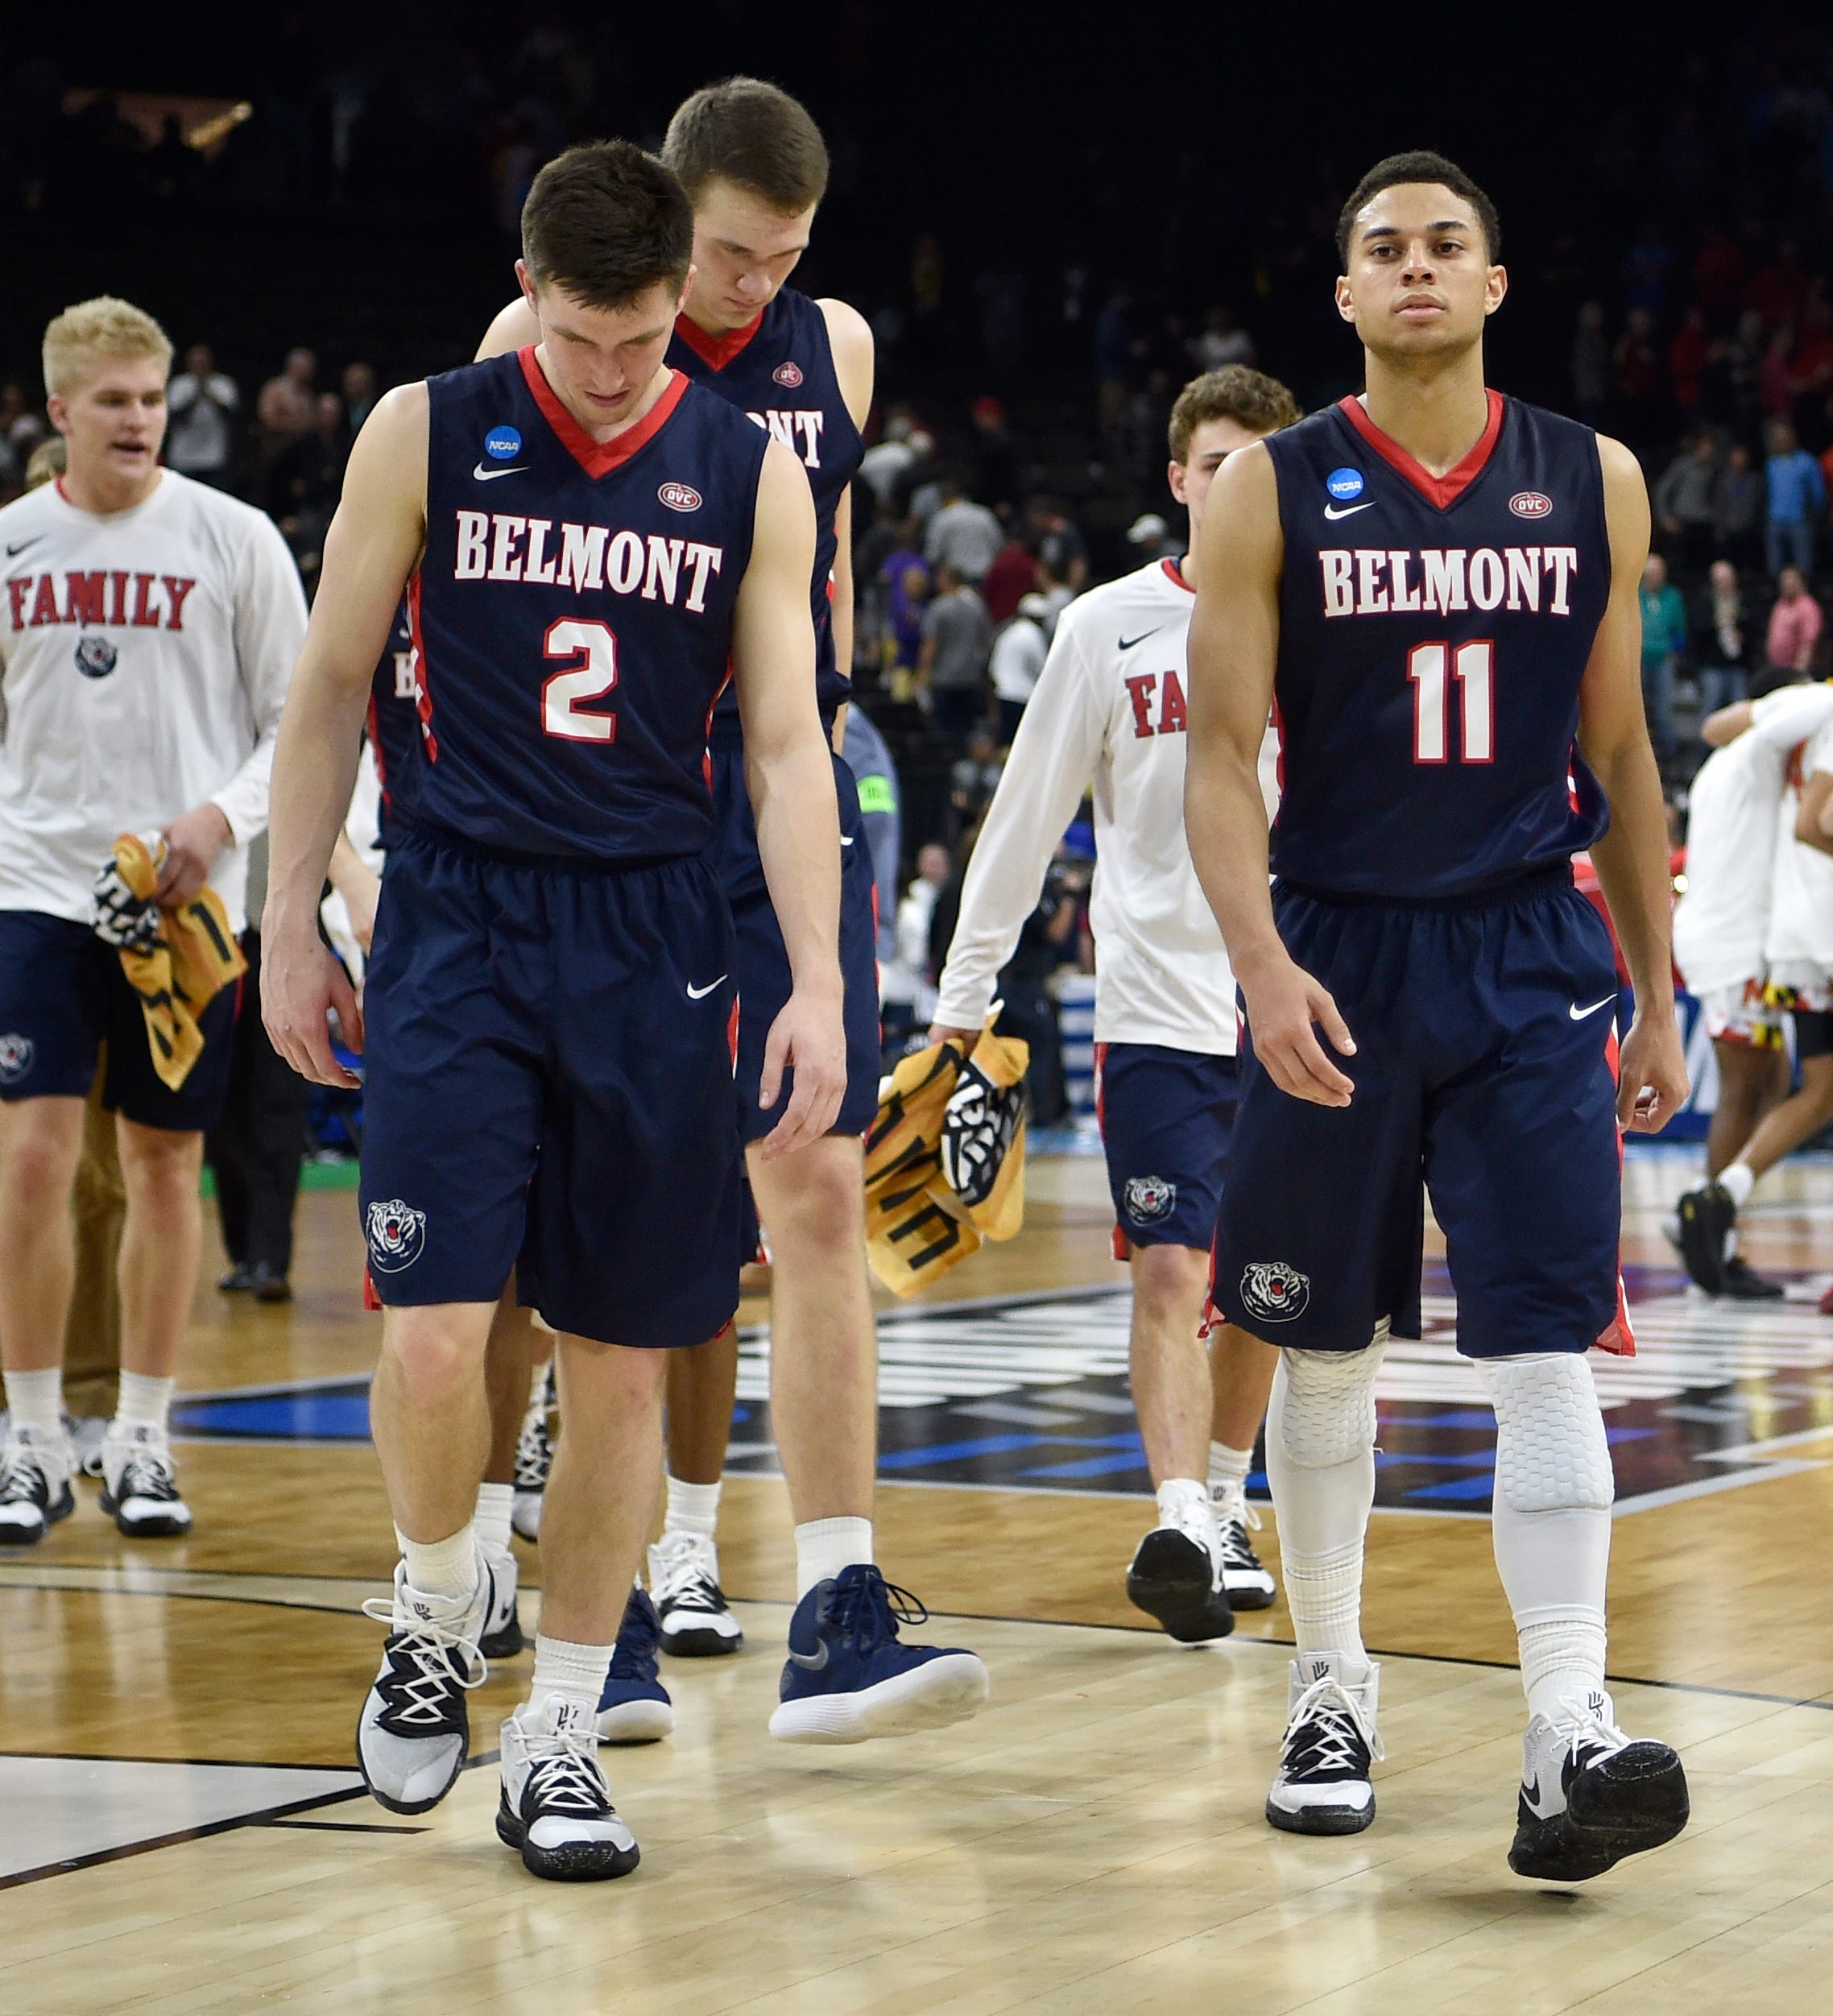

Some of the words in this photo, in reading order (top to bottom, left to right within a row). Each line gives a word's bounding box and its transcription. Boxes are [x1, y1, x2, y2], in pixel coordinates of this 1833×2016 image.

[489, 440, 519, 451] NCAA
[746, 409, 824, 469] NT
[667, 490, 693, 504] OVC
[1331, 480, 1362, 492] NCAA
[1518, 499, 1543, 510] OVC
[454, 510, 722, 614] BELMONT
[1318, 546, 1578, 618] BELMONT
[7, 570, 196, 632] FAMILY
[541, 616, 618, 743] 2
[1406, 638, 1496, 764] 11
